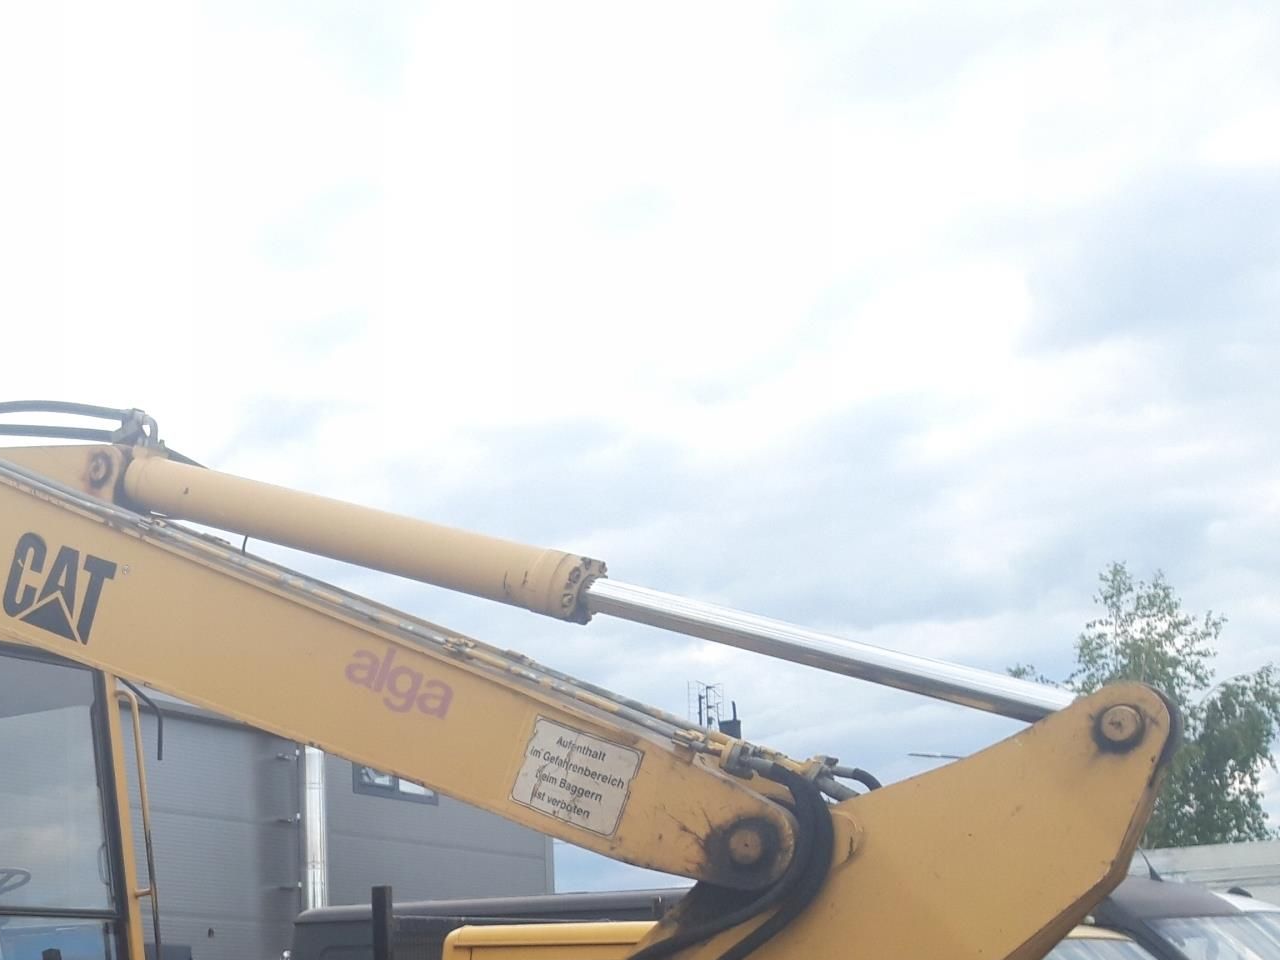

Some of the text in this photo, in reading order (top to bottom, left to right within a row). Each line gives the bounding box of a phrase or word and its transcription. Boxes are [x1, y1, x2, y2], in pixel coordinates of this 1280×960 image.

[3, 532, 117, 646] CAT
[345, 647, 454, 720] alga
[559, 778, 602, 803] Baggern
